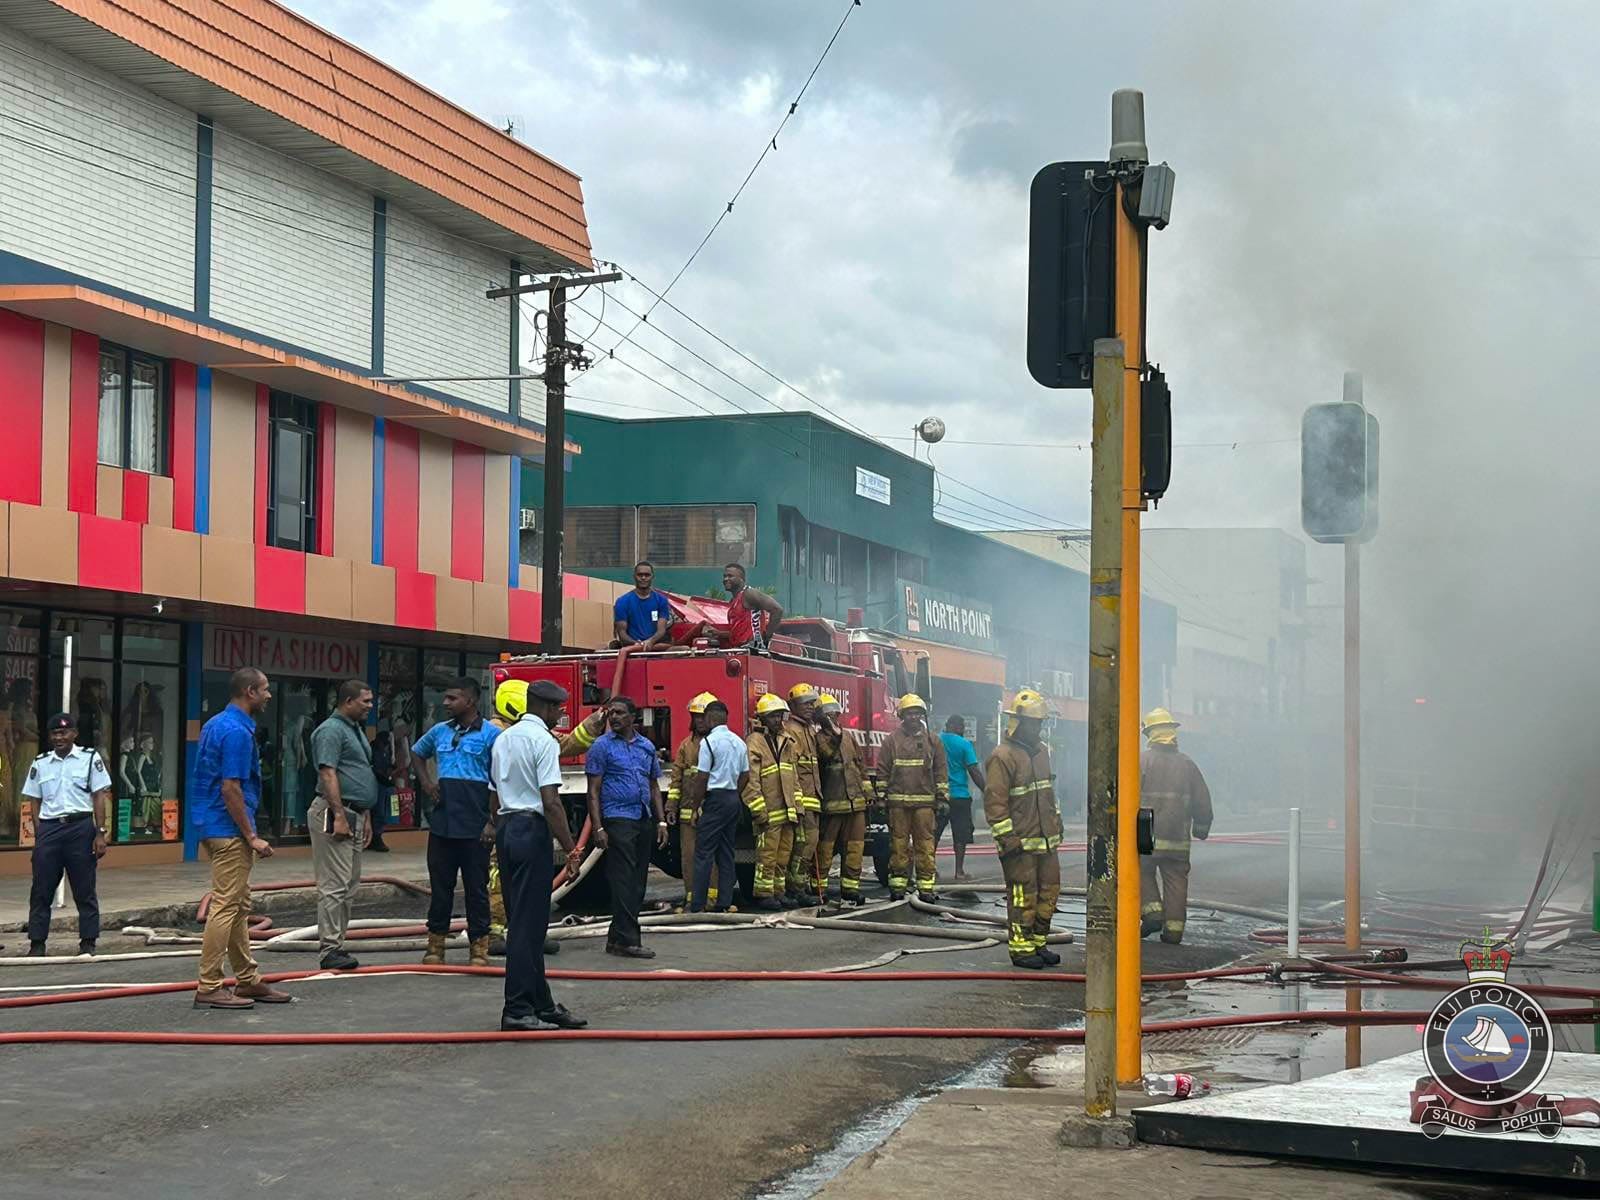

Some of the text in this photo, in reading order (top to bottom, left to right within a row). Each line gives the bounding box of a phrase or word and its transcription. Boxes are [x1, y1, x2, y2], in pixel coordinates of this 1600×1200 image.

[924, 597, 960, 633] NORTH
[960, 607, 992, 640] POINT
[5, 658, 34, 680] SALE
[257, 634, 361, 674] FASHION
